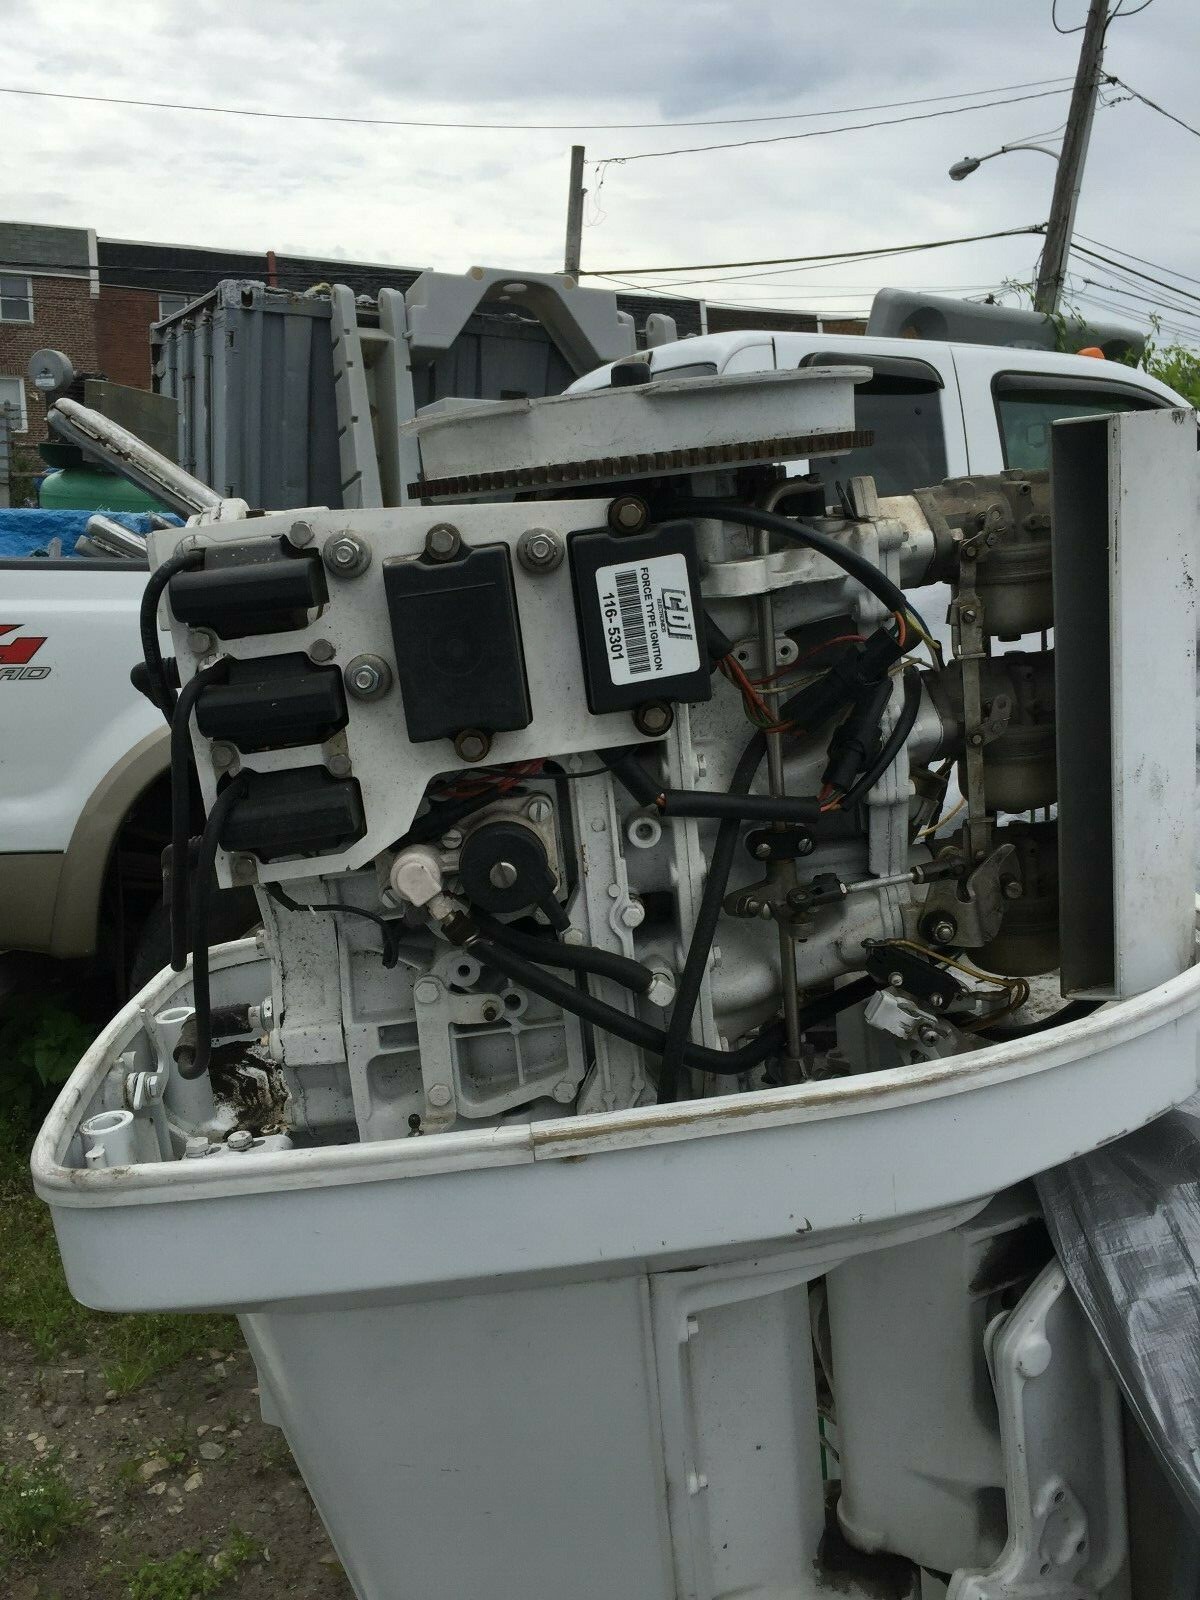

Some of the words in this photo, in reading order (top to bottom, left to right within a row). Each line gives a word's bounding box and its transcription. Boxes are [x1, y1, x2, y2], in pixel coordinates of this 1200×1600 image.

[640, 567, 653, 601] FORCE
[646, 602, 657, 627] TYPE
[657, 598, 667, 633] ELECTRONICS
[661, 587, 693, 640] CDI
[650, 629, 663, 671] IGNITION
